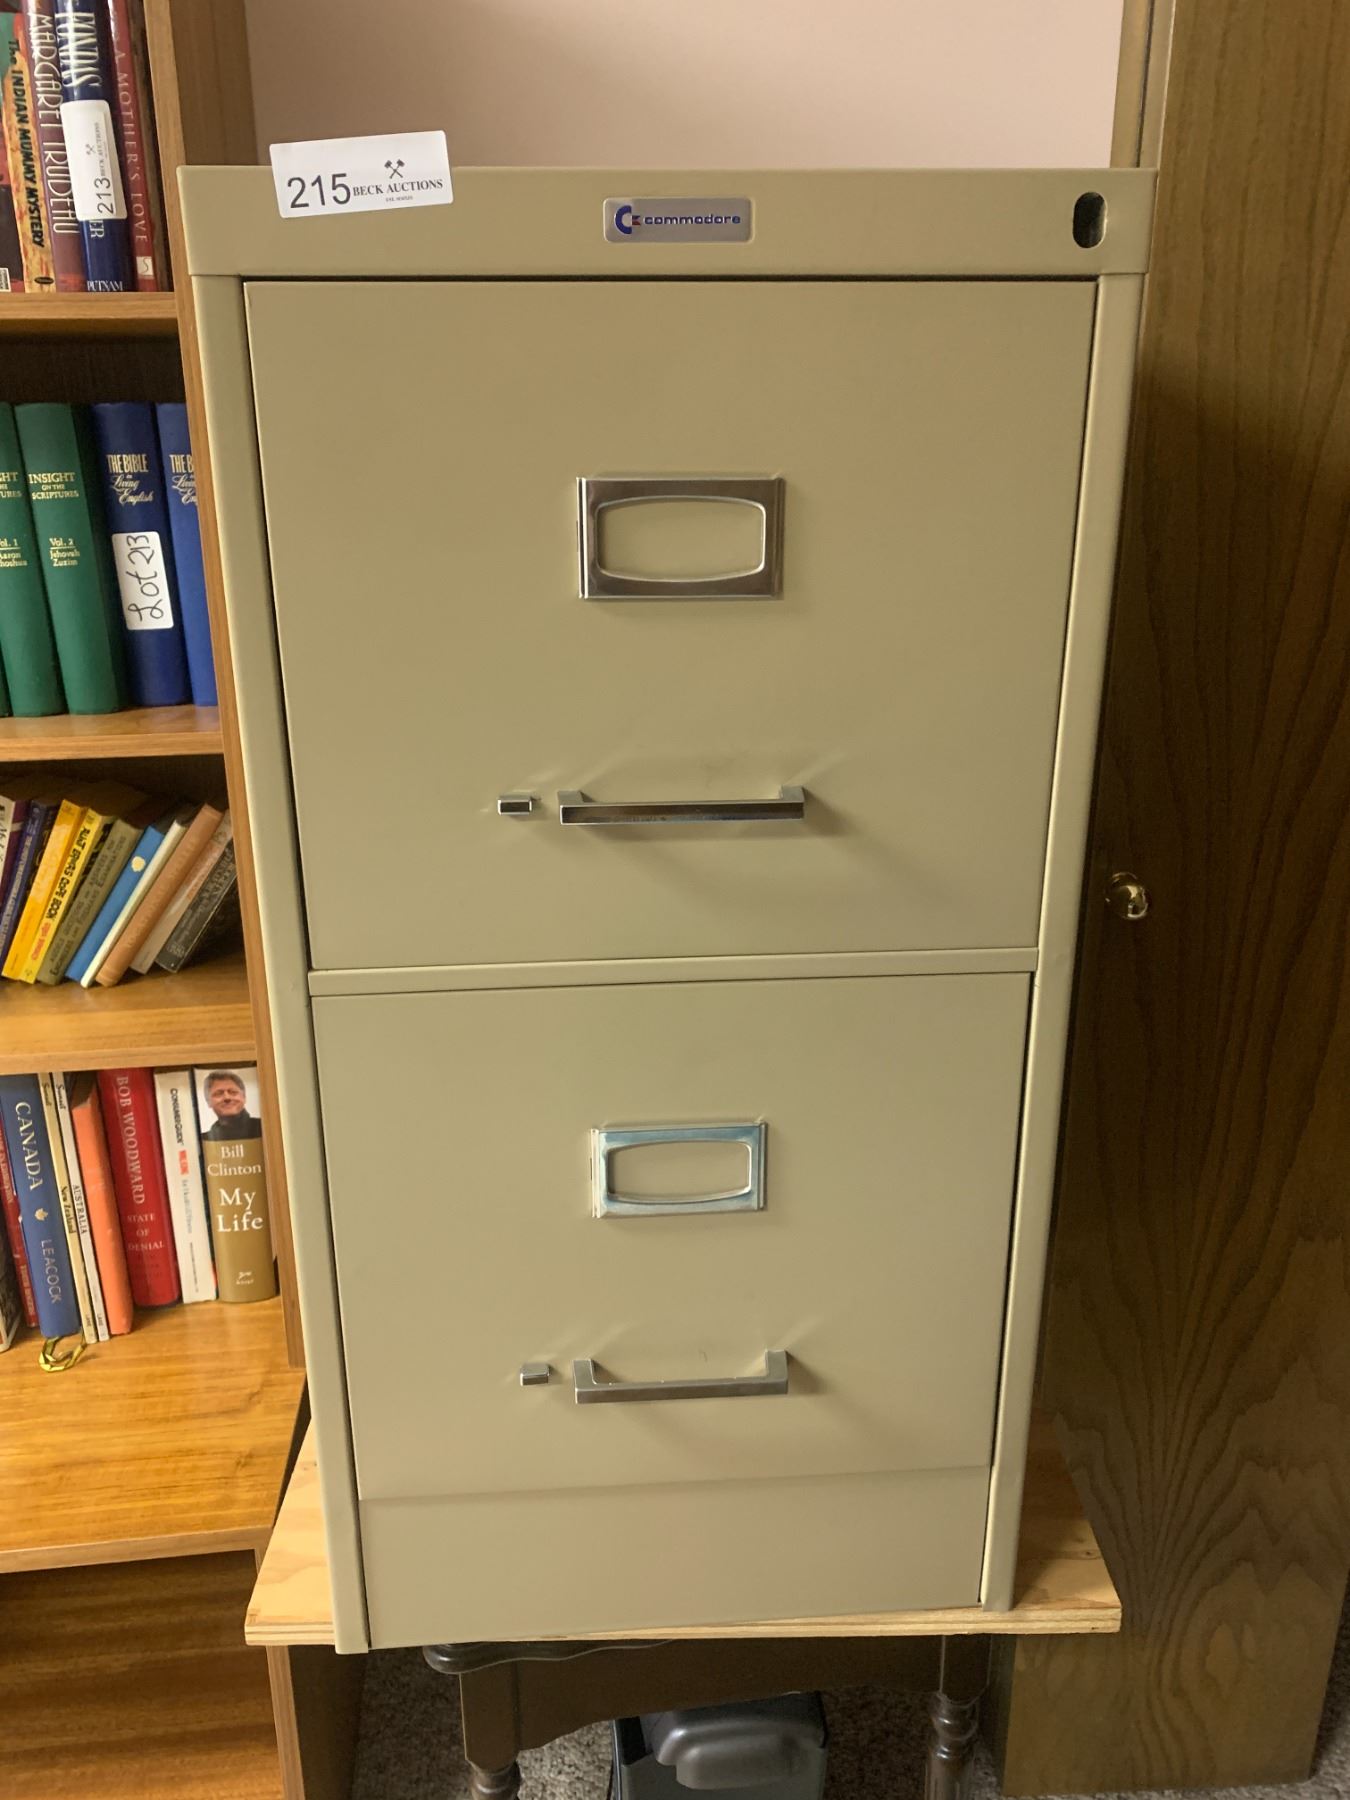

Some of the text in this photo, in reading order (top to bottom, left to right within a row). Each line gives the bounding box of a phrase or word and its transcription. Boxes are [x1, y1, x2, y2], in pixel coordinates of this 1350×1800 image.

[11, 70, 29, 124] INDIAN
[28, 13, 80, 233] MARGARET TRUDEAU
[17, 128, 37, 184] MUMMY
[118, 72, 141, 181] MOTHER'S
[130, 193, 148, 242] LOVE
[94, 177, 115, 215] 213
[287, 173, 443, 208] 215 BECK AUCTIONS
[25, 186, 45, 248] MYSTERY
[644, 213, 741, 225] commodore
[87, 280, 123, 292] PUTNAM
[106, 453, 149, 473] THE BIBLE
[169, 453, 187, 473] THE
[28, 472, 76, 484] INSIGHT
[31, 490, 79, 500] SCRIPTURES
[49, 537, 67, 547] Vol.
[126, 535, 164, 622] Lot 213
[15, 1101, 43, 1190] CANADA
[116, 1076, 145, 1205] BOB WOODWARD
[221, 1143, 244, 1159] Bill
[207, 1163, 262, 1177] Clinton
[73, 1184, 88, 1234] AUSTRALIA
[219, 1187, 257, 1211] My
[127, 1213, 155, 1222] STATE
[217, 1210, 264, 1233] Life
[41, 1239, 62, 1303] LEACOCK
